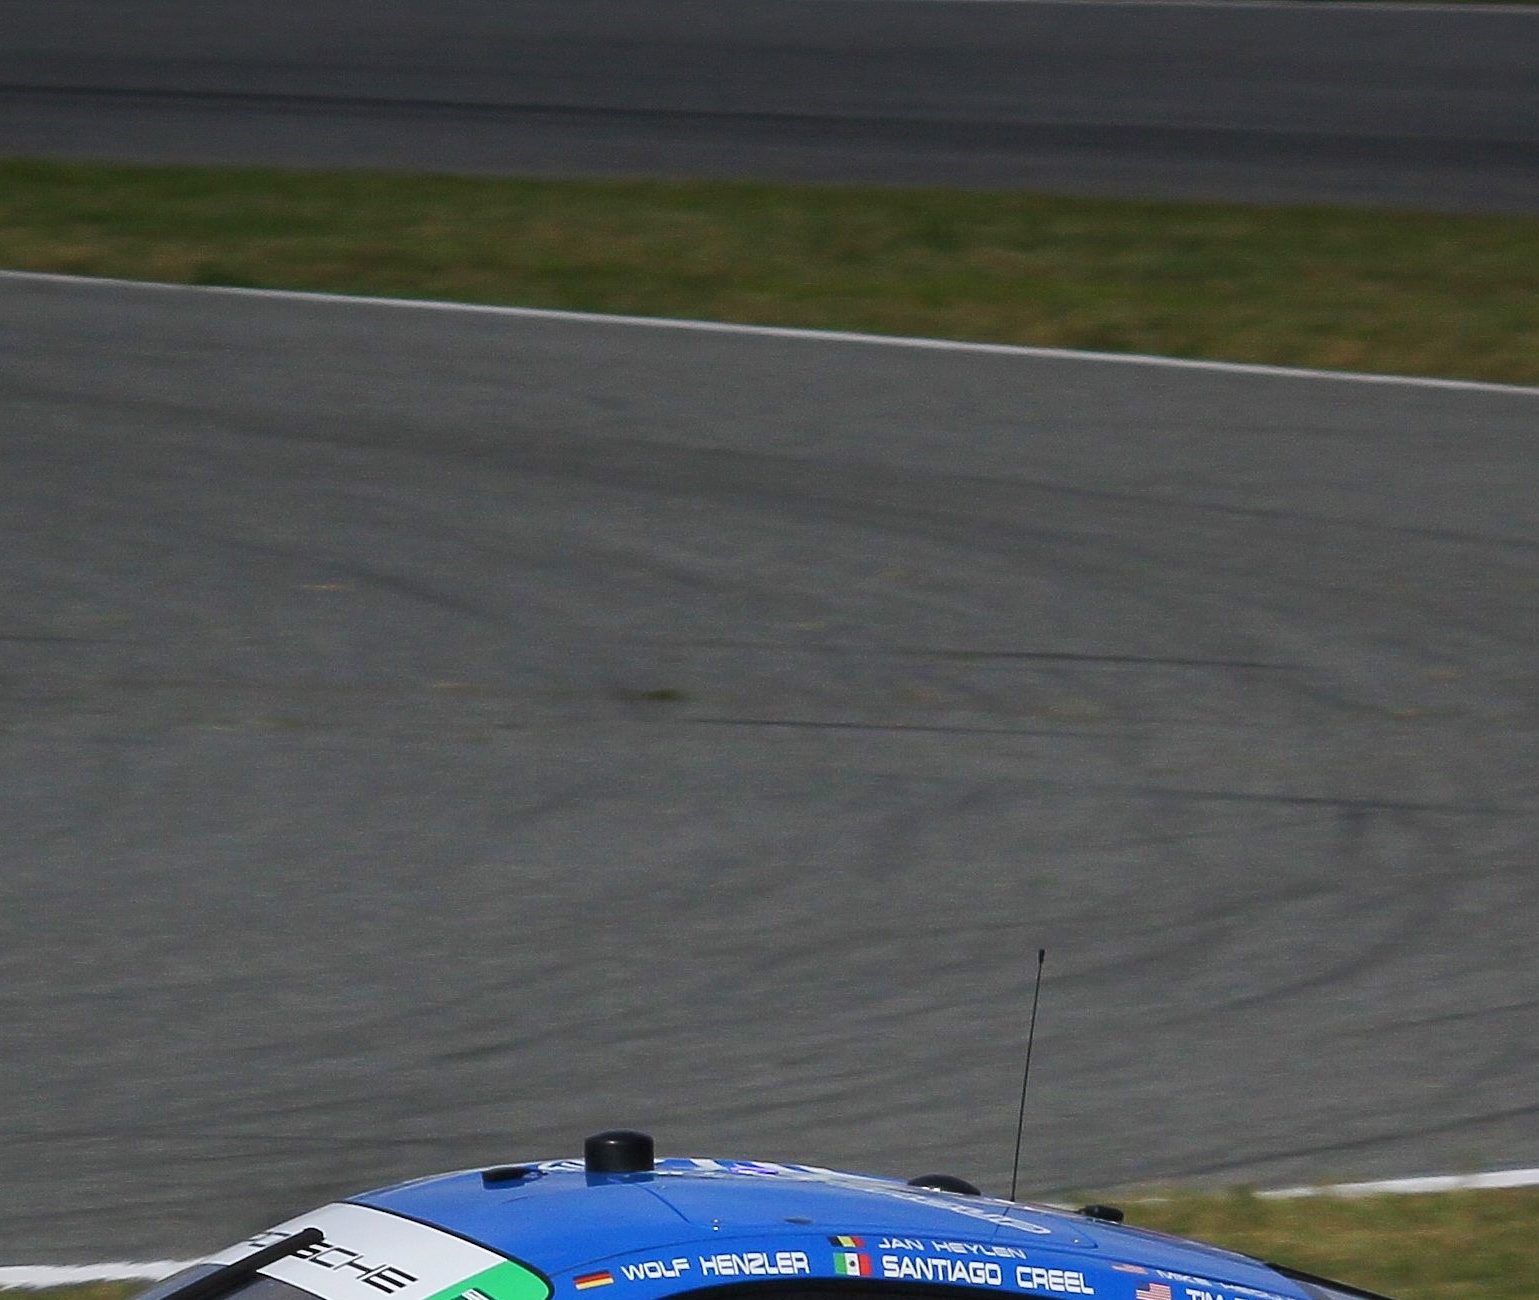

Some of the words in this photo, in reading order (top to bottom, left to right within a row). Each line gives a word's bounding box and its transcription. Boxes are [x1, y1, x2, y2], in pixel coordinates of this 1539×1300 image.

[879, 1238, 924, 1250] JAN
[932, 1241, 1027, 1259] HEYLEN
[620, 1258, 690, 1281] WOLF
[699, 1251, 810, 1276] HENZLER
[882, 1255, 1002, 1286] SANTIAGO
[1016, 1265, 1095, 1295] CREEL
